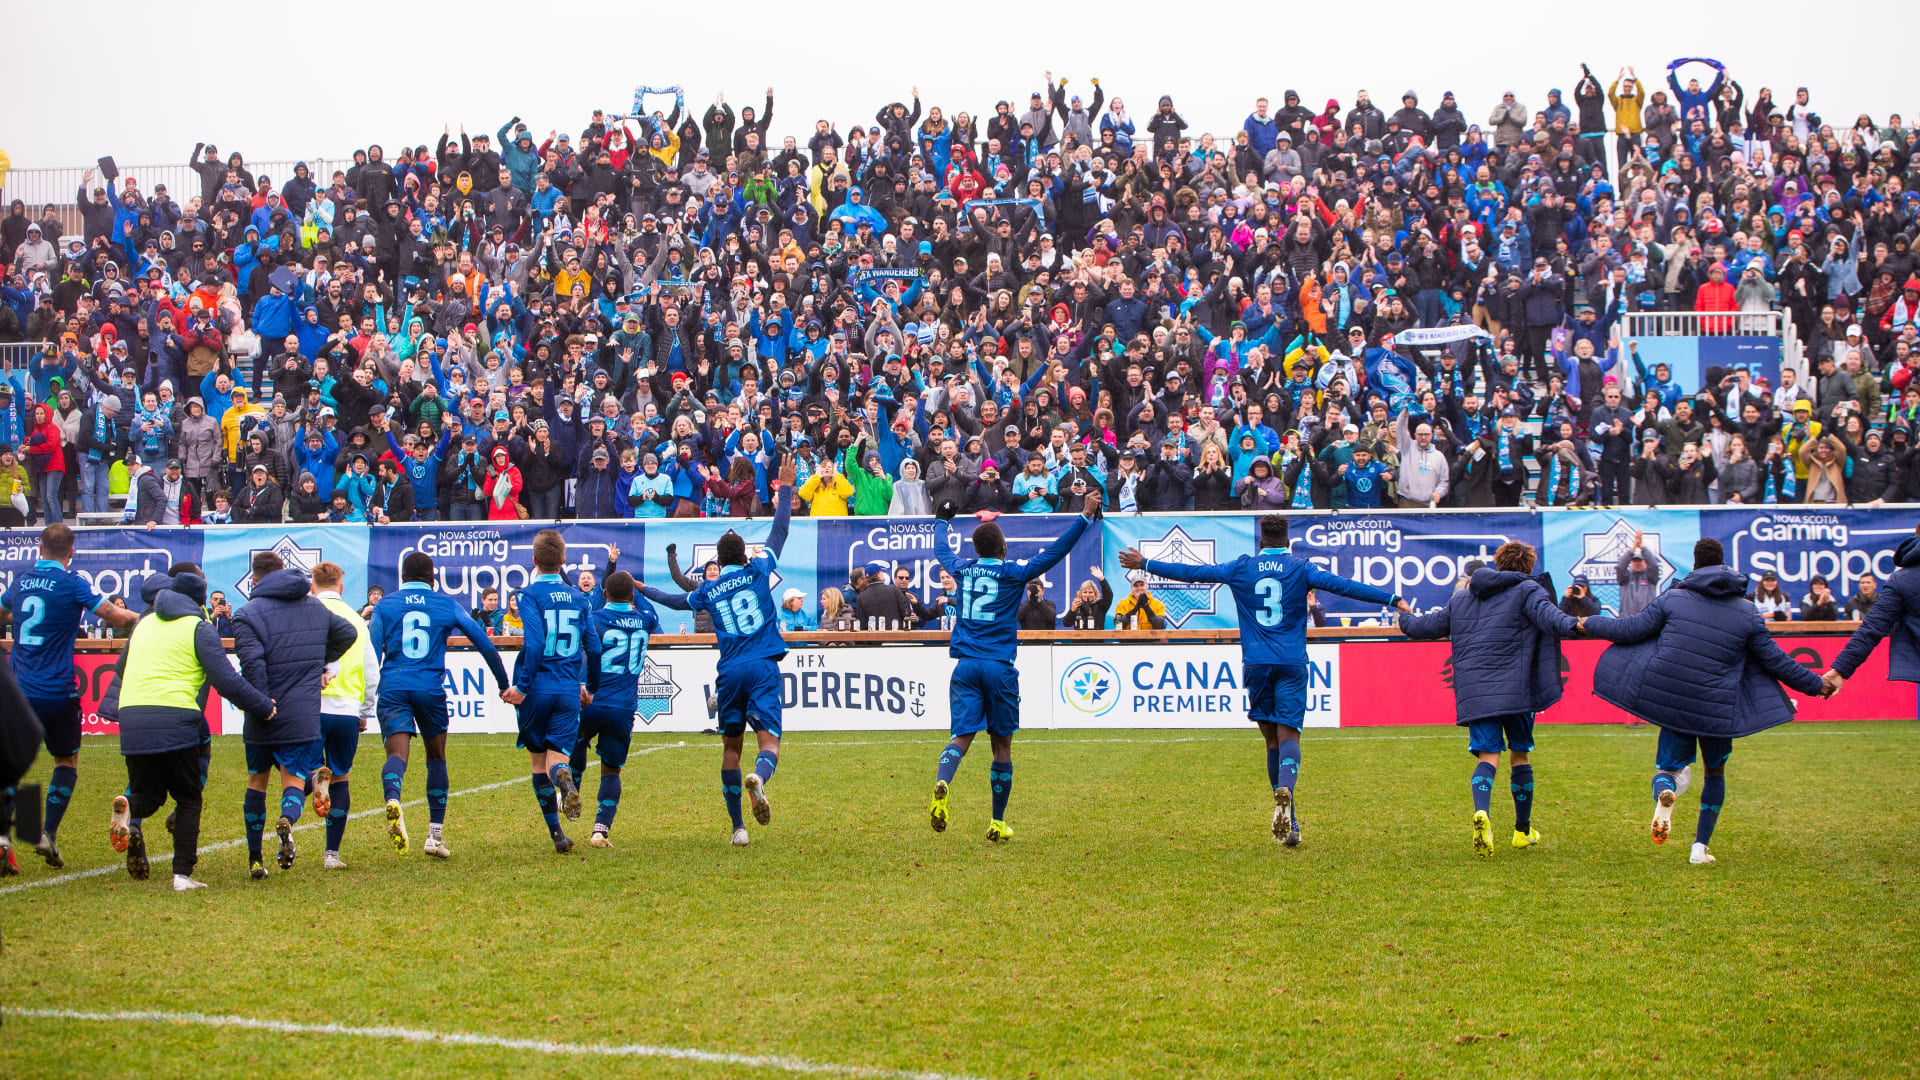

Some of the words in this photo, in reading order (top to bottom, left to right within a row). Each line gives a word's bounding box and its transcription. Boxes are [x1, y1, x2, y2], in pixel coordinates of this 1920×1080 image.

[872, 268, 919, 277] WANDERERS
[889, 524, 917, 533] NOVA
[1327, 521, 1356, 530] NOVA
[1357, 520, 1393, 529] SCOTIA
[1750, 517, 1848, 547] Gaming
[1773, 515, 1801, 524] NOVA
[1802, 515, 1839, 524] SCOTIA
[7, 537, 33, 545] NOVA
[417, 534, 509, 562] Gaming
[439, 531, 465, 540] NOVA
[467, 530, 500, 539] SCOTIA
[867, 526, 962, 555] Gamig
[1305, 524, 1401, 553] Gaming
[1258, 561, 1283, 573] BONA
[1749, 550, 1902, 597] suppo
[20, 578, 56, 592] SCHAALE
[550, 591, 572, 603] FIRTH
[961, 576, 999, 621] 12
[715, 589, 765, 636] 18
[1254, 577, 1283, 627] 3
[19, 595, 46, 646] 2
[402, 611, 431, 659] 6
[544, 609, 581, 658] 15
[600, 629, 649, 675] 20
[796, 654, 825, 667] HFX
[1132, 661, 1331, 690] CANAN
[703, 671, 906, 720] DERERS
[909, 680, 926, 697] FC
[1134, 695, 1232, 712] PREMIER
